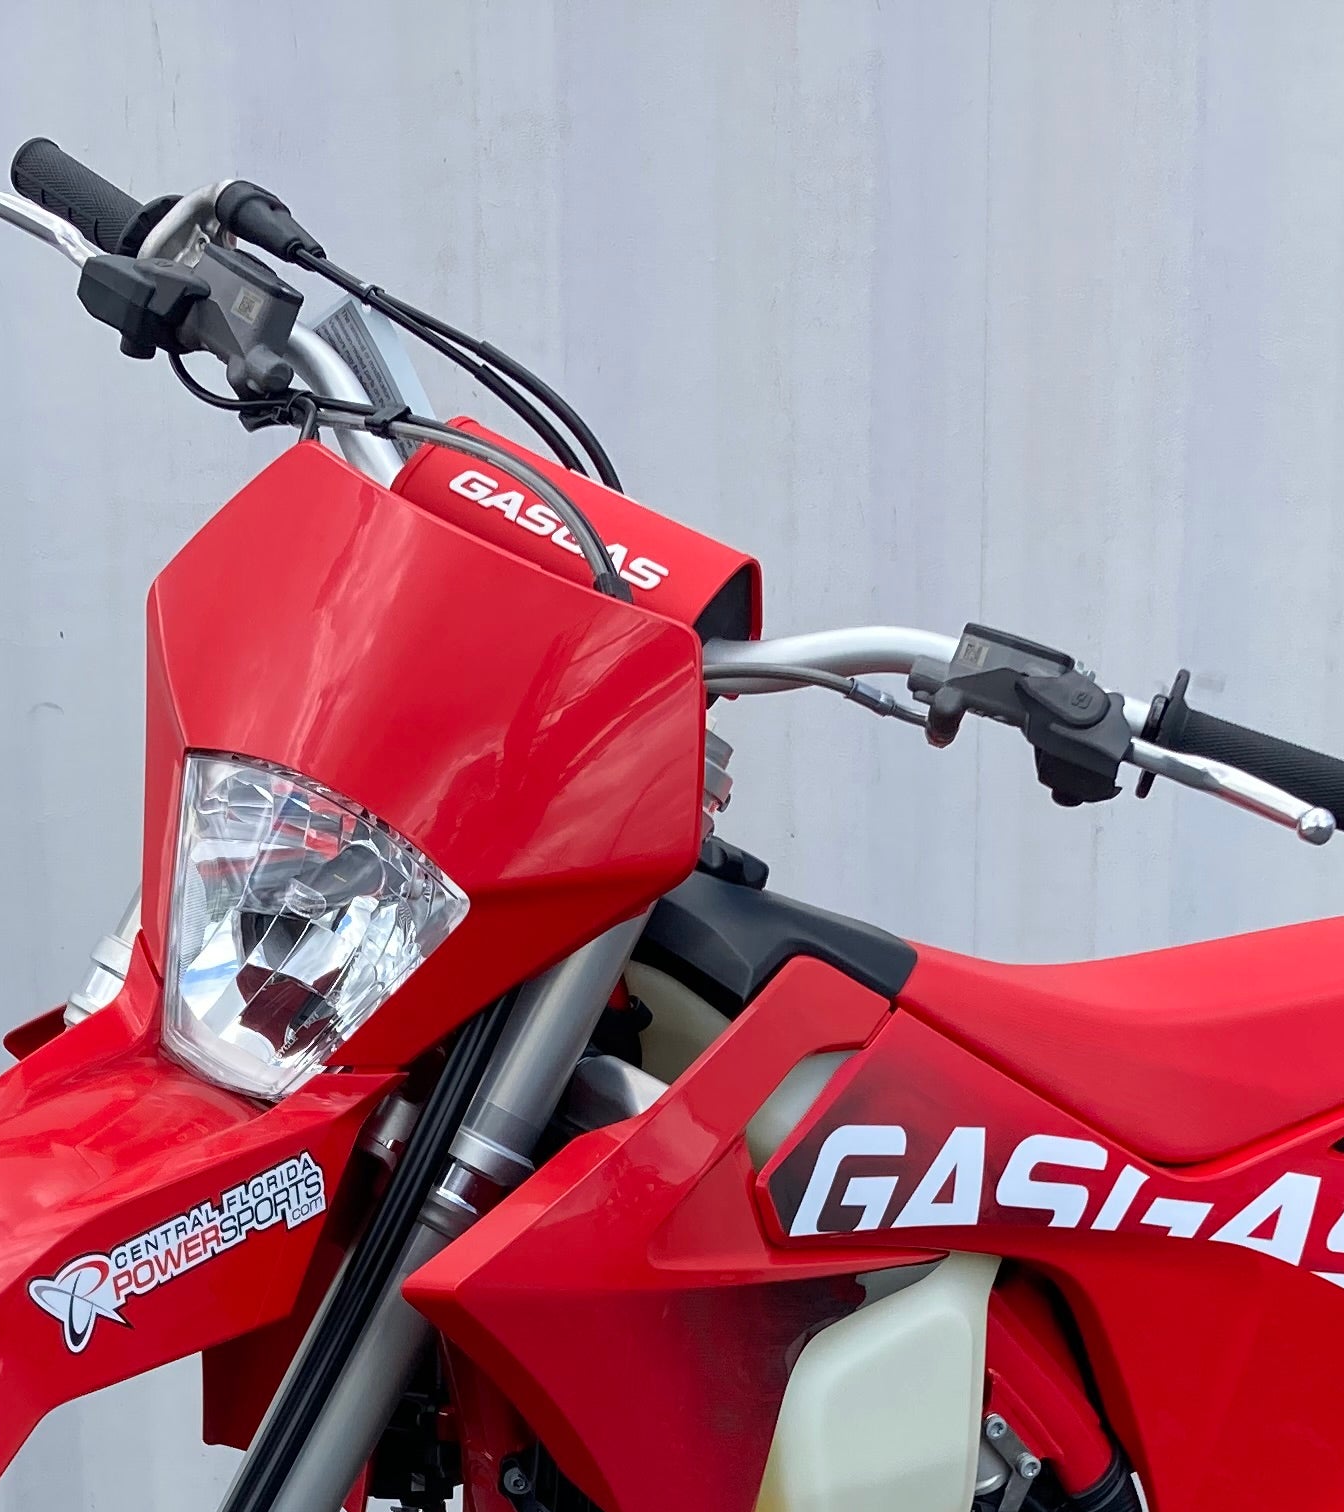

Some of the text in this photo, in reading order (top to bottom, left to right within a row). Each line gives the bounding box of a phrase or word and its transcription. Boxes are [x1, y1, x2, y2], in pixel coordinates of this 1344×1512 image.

[112, 1170, 322, 1301] POWERSPORTS
[114, 1157, 313, 1270] CENTRAL FLORIDA
